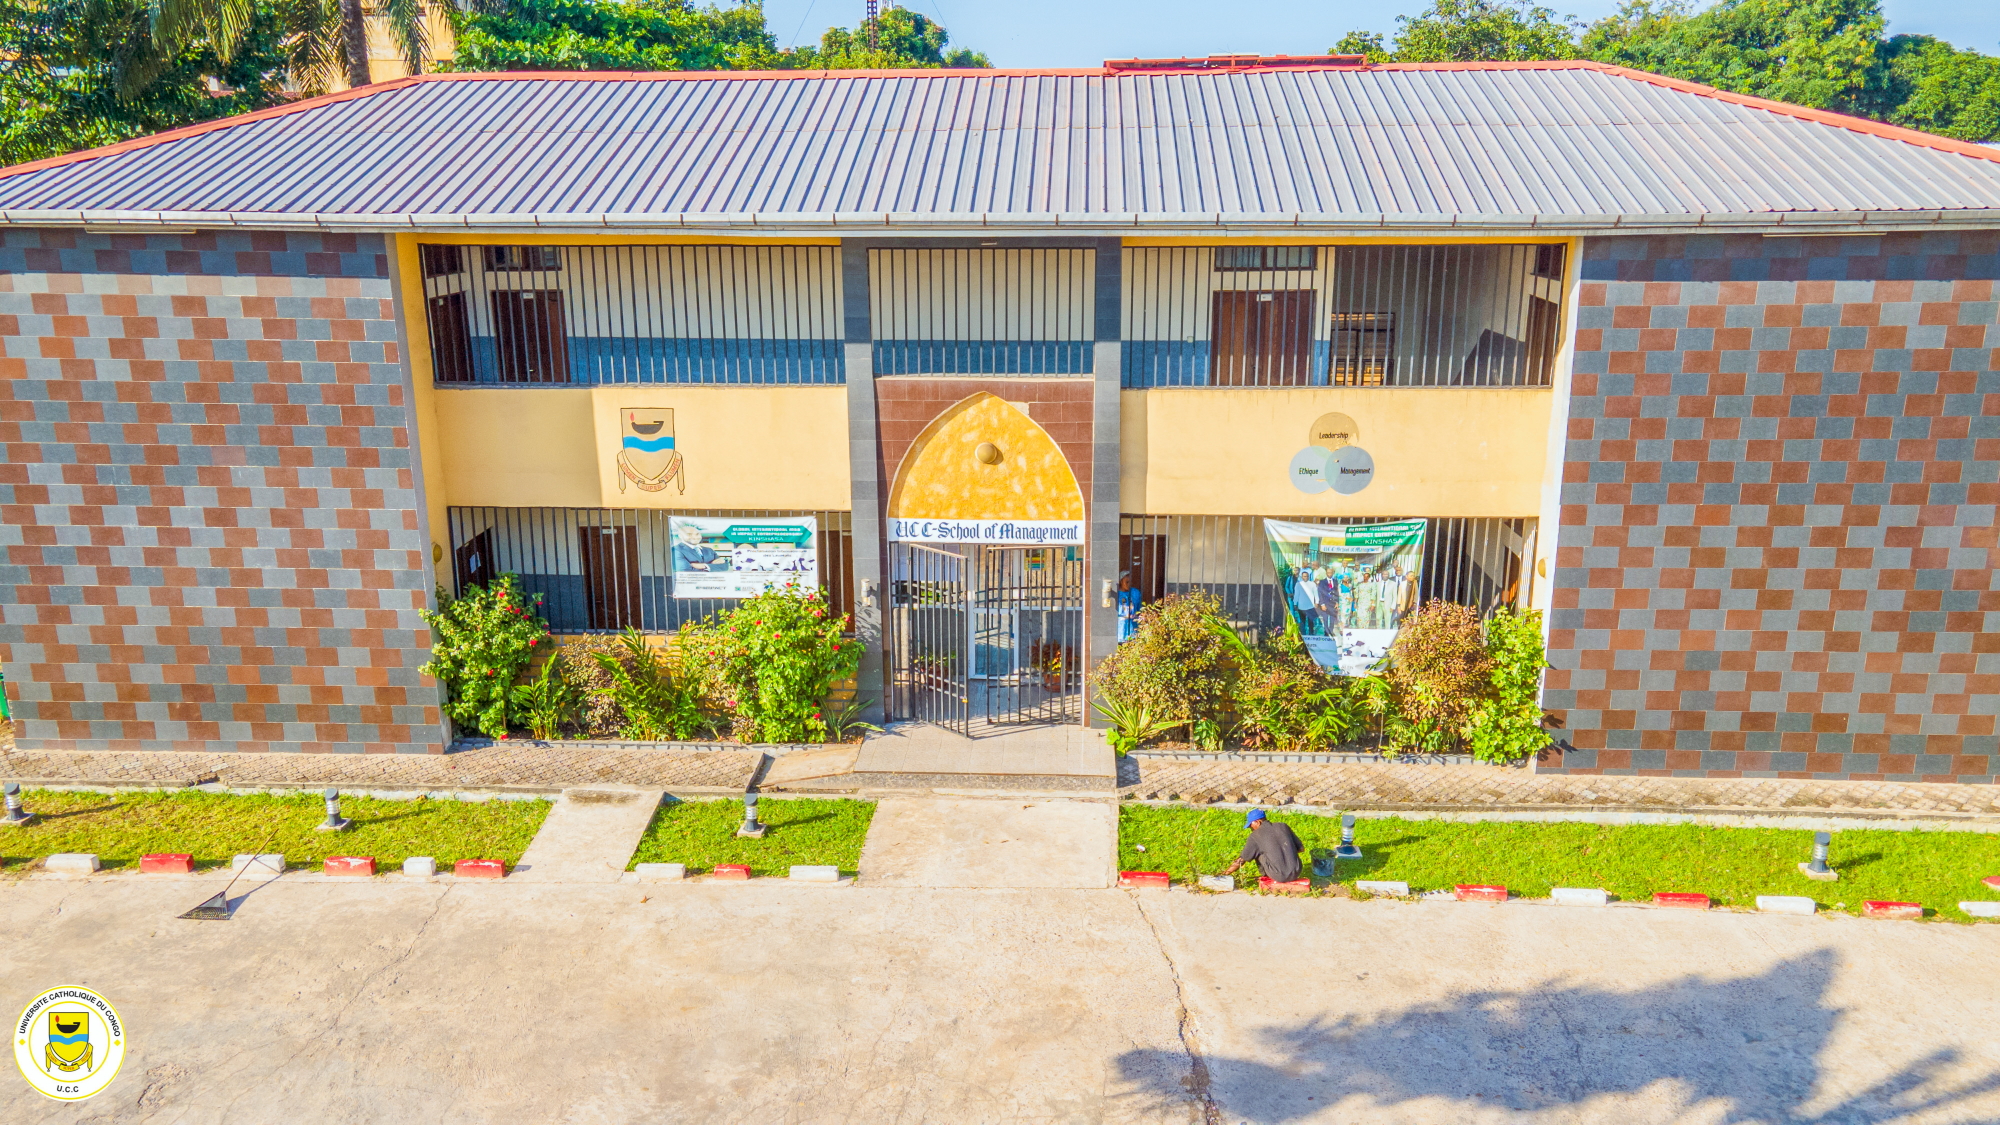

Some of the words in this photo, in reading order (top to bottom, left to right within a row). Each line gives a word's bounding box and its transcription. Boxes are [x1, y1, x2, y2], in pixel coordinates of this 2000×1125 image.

[1318, 432, 1349, 440] Leadership
[1340, 467, 1371, 476] Management
[984, 522, 999, 539] of
[999, 523, 1078, 543] Management
